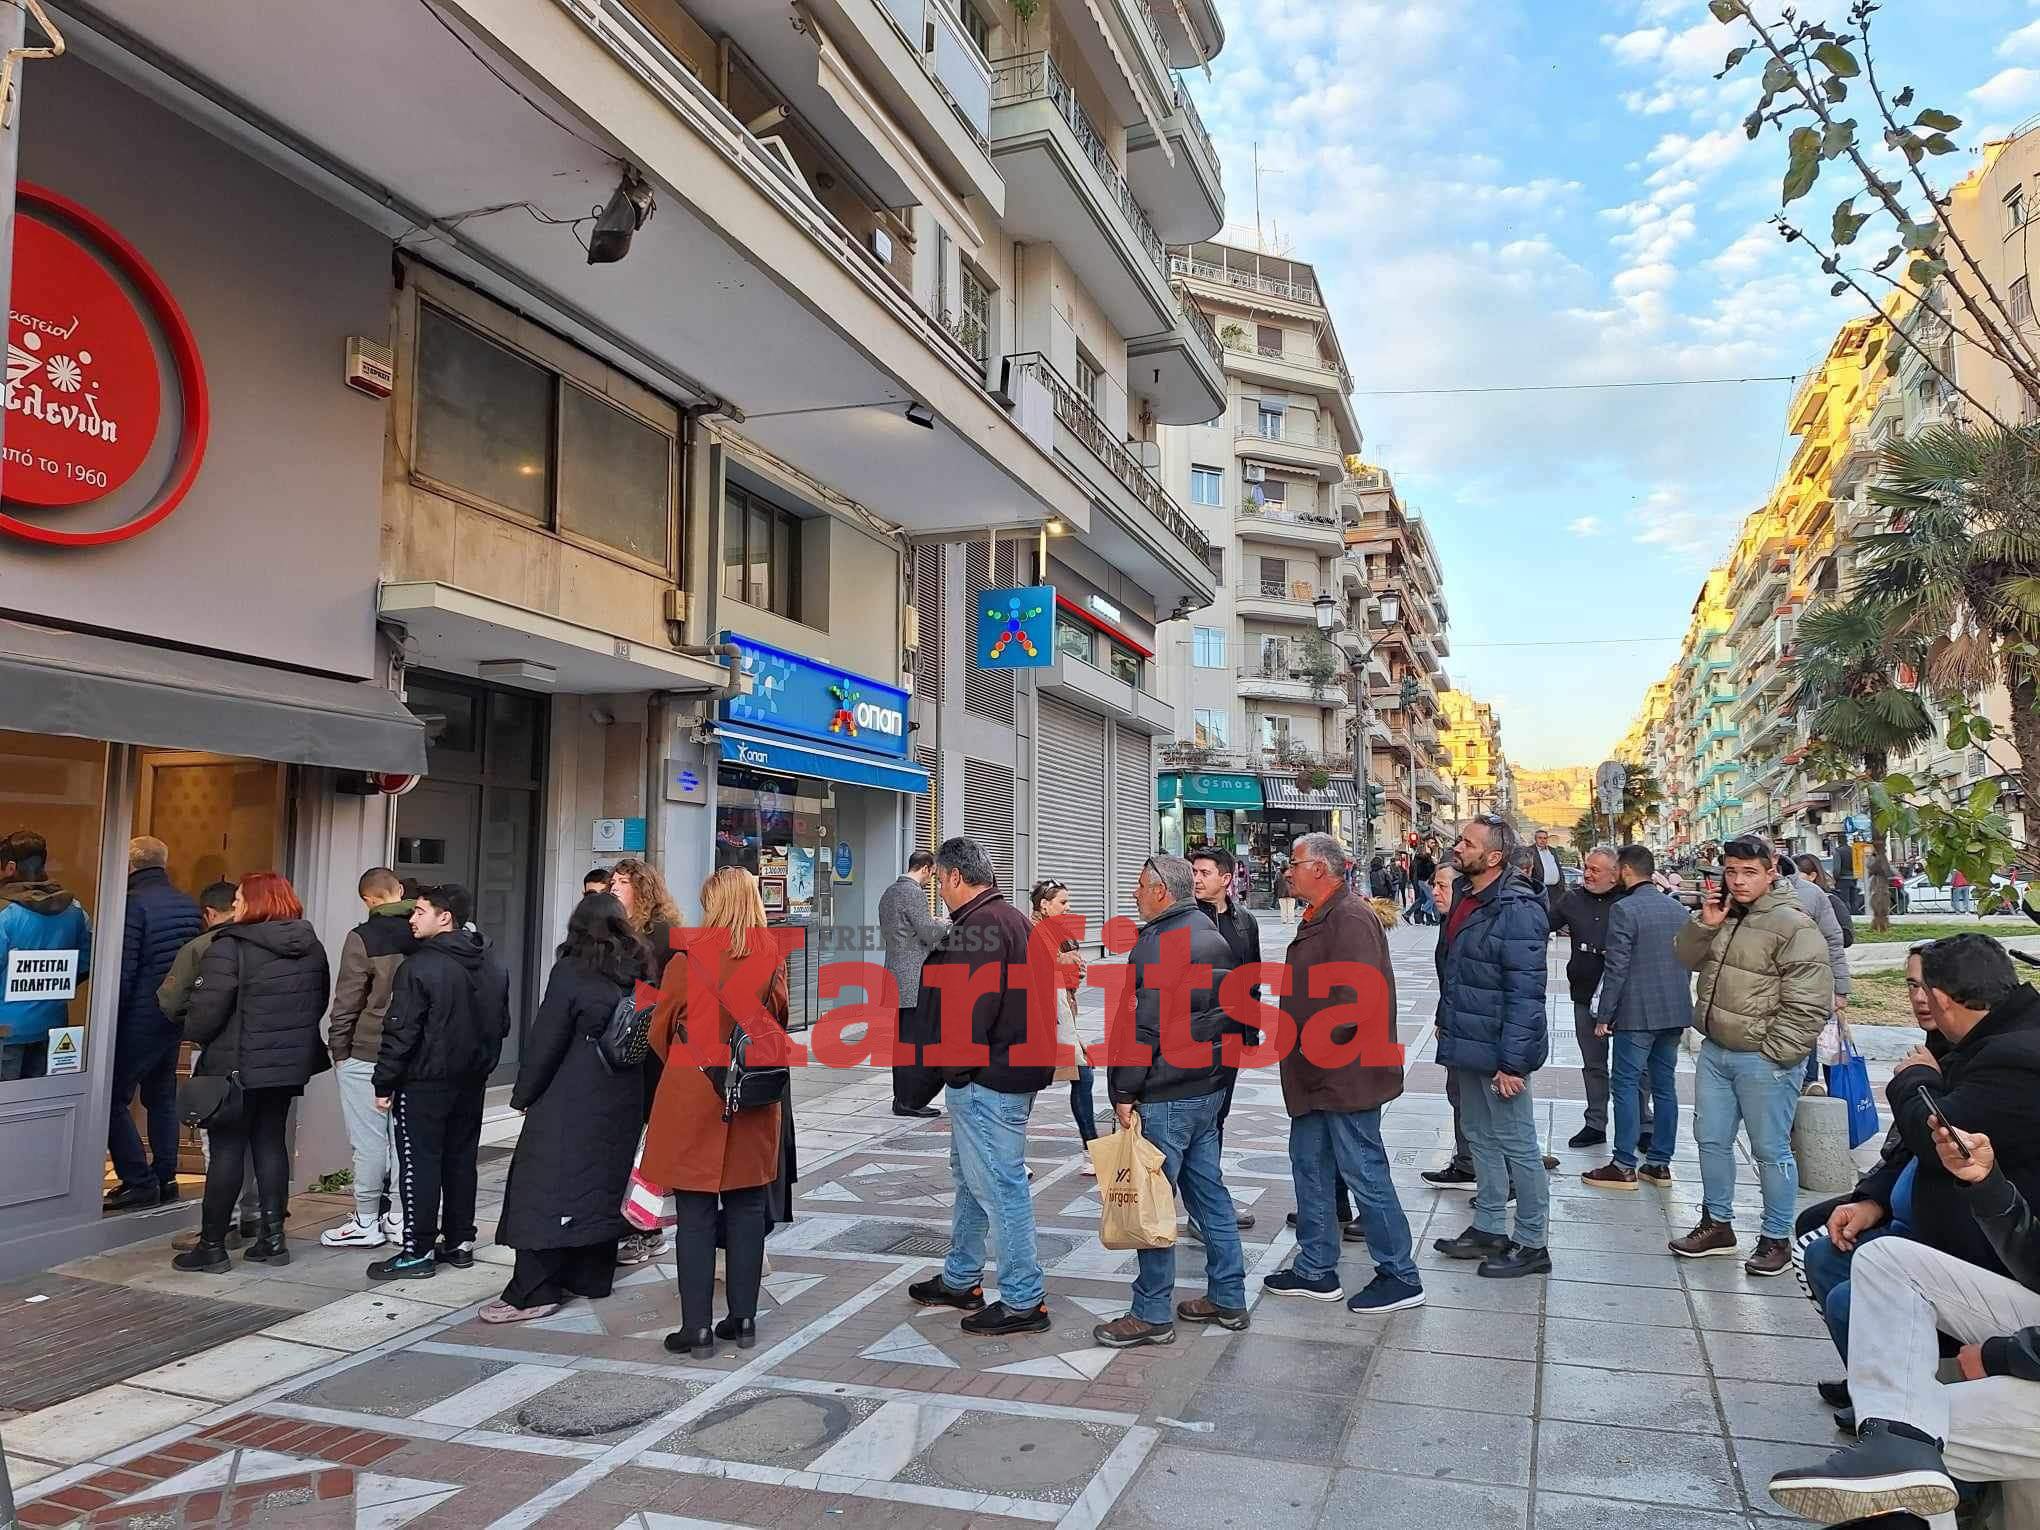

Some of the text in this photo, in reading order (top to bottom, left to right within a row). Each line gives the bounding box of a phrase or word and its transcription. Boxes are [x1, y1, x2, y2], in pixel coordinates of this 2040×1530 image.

[37, 457, 58, 474] το
[65, 462, 107, 488] 1960
[16, 959, 69, 973] ΖΗΤΕΙΤΑΙ
[10, 978, 71, 993] ΠΩΛΗΤΡΙΑ
